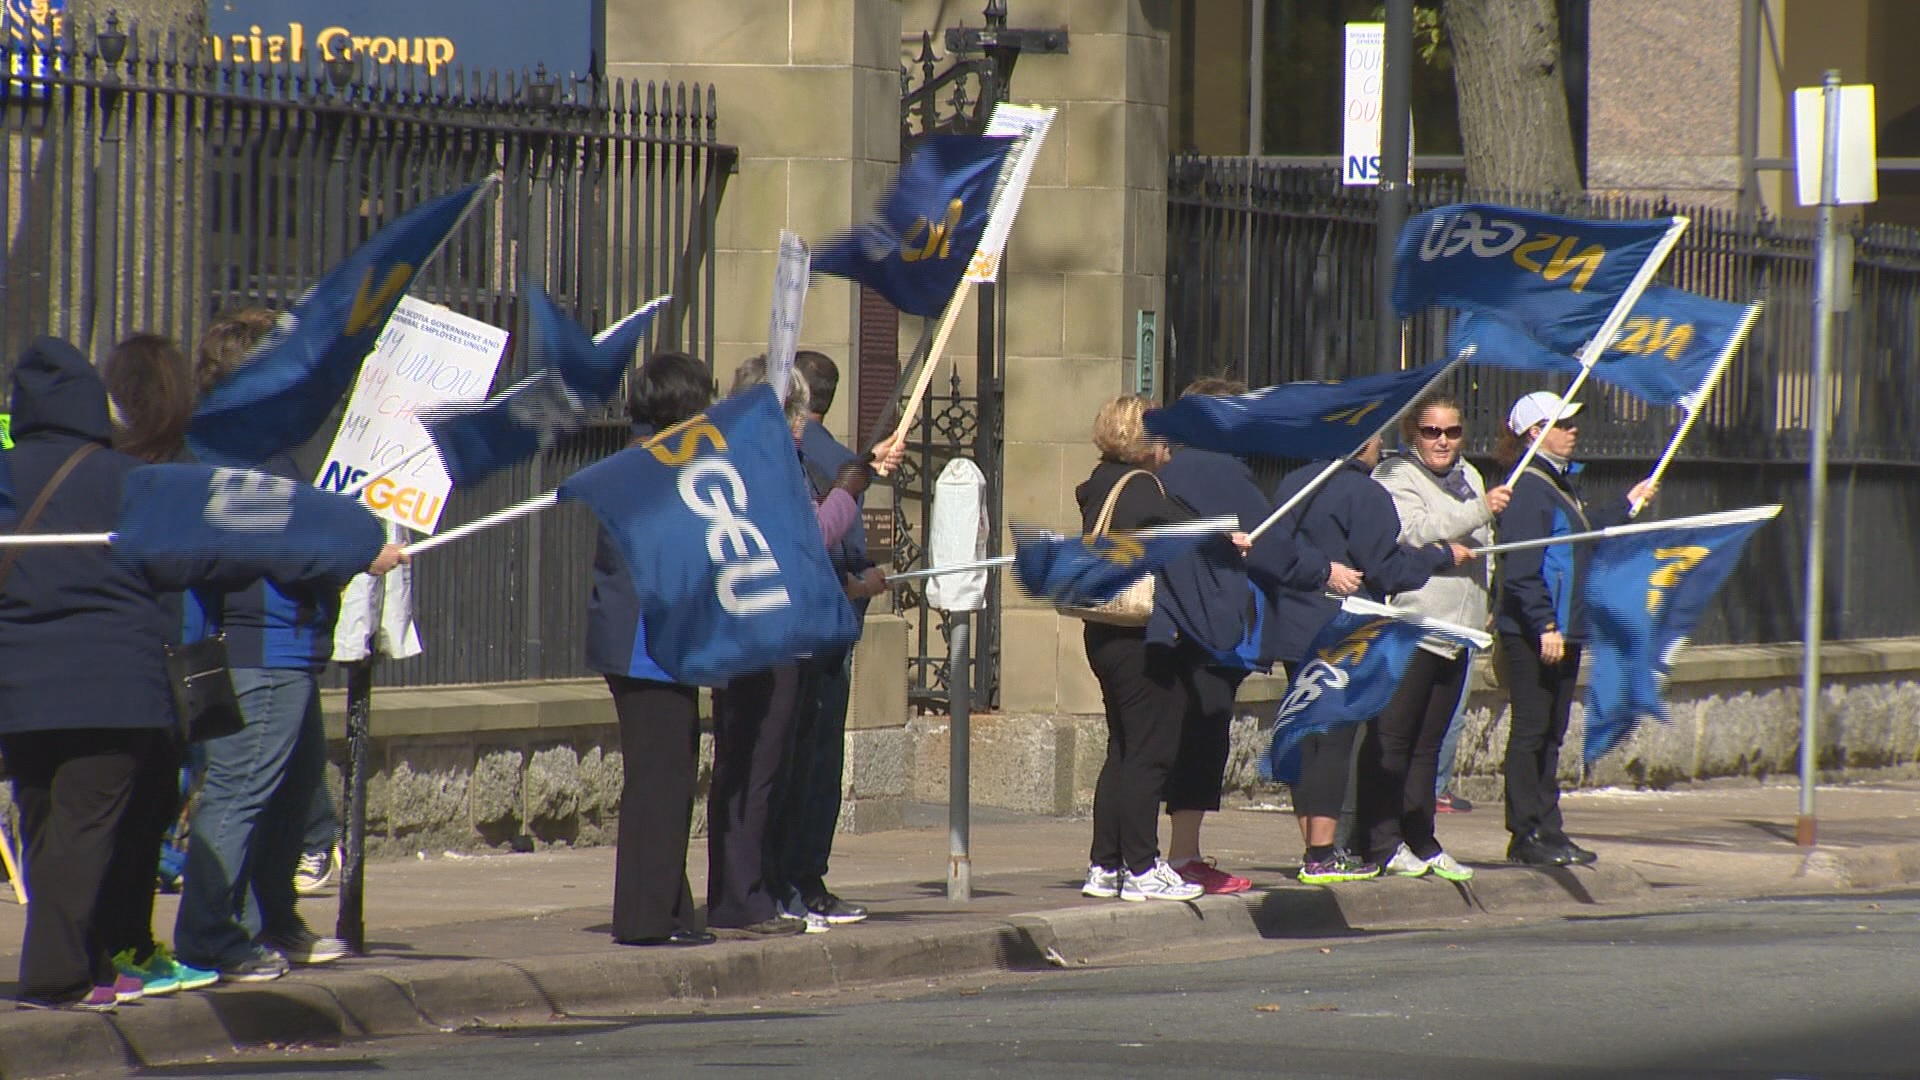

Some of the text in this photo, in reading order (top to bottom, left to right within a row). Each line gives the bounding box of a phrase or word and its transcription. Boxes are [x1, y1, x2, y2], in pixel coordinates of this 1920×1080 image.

[317, 26, 455, 77] Group
[1349, 99, 1381, 123] OU
[406, 309, 429, 324] SCOTIA
[430, 319, 481, 342] GOVERNMENT
[482, 338, 500, 349] AND
[420, 323, 462, 342] EMPLOYEES
[463, 339, 488, 354] UNION
[395, 351, 481, 396] UNION
[339, 411, 371, 443] MY
